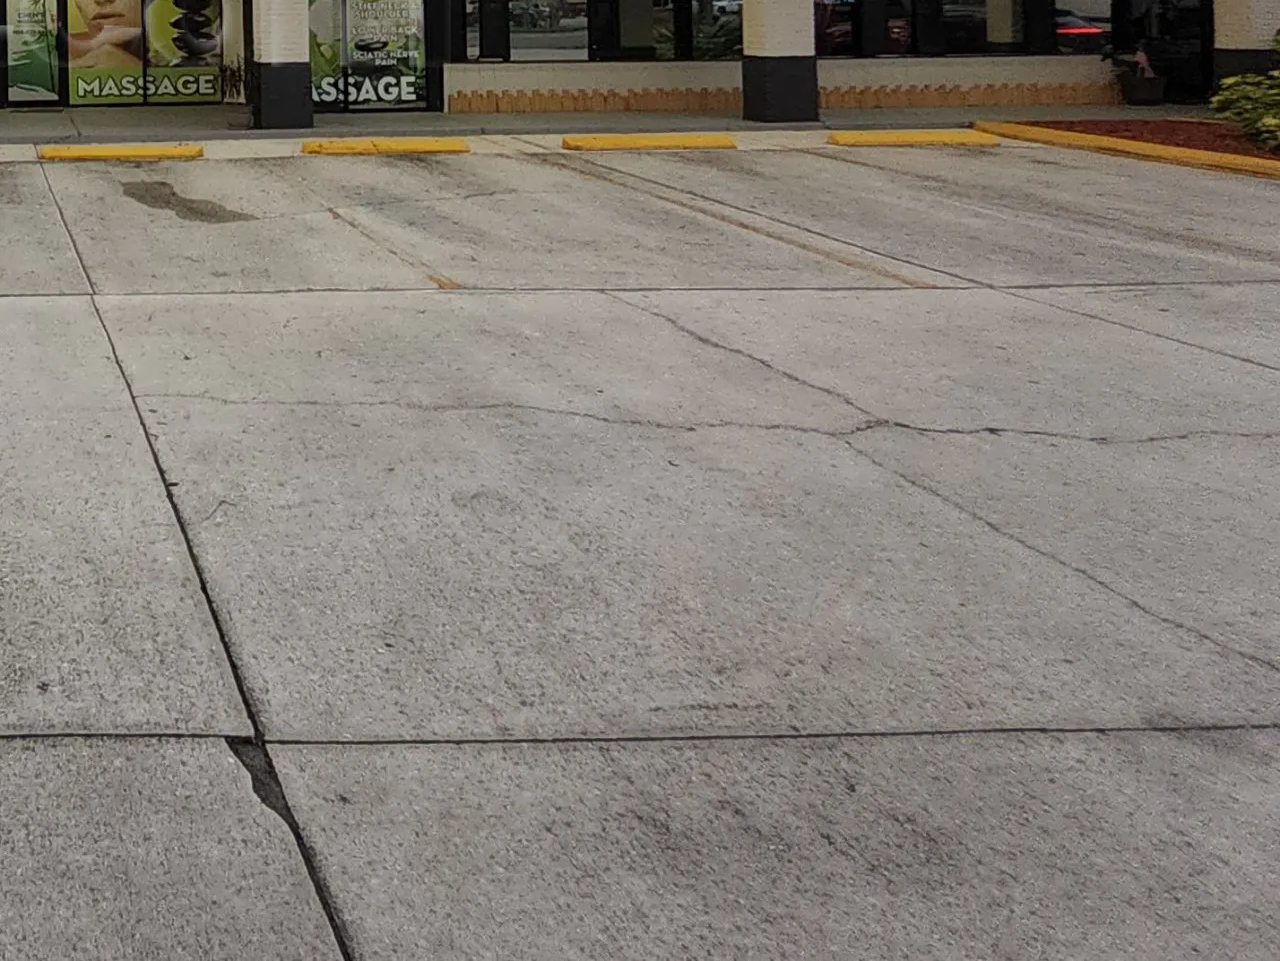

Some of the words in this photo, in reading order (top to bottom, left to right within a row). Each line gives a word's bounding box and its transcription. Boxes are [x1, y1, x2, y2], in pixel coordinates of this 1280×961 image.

[353, 50, 389, 59] SCIATIC
[390, 49, 420, 58] NERVE
[375, 58, 397, 66] PAIN
[77, 74, 216, 98] MASSAGE
